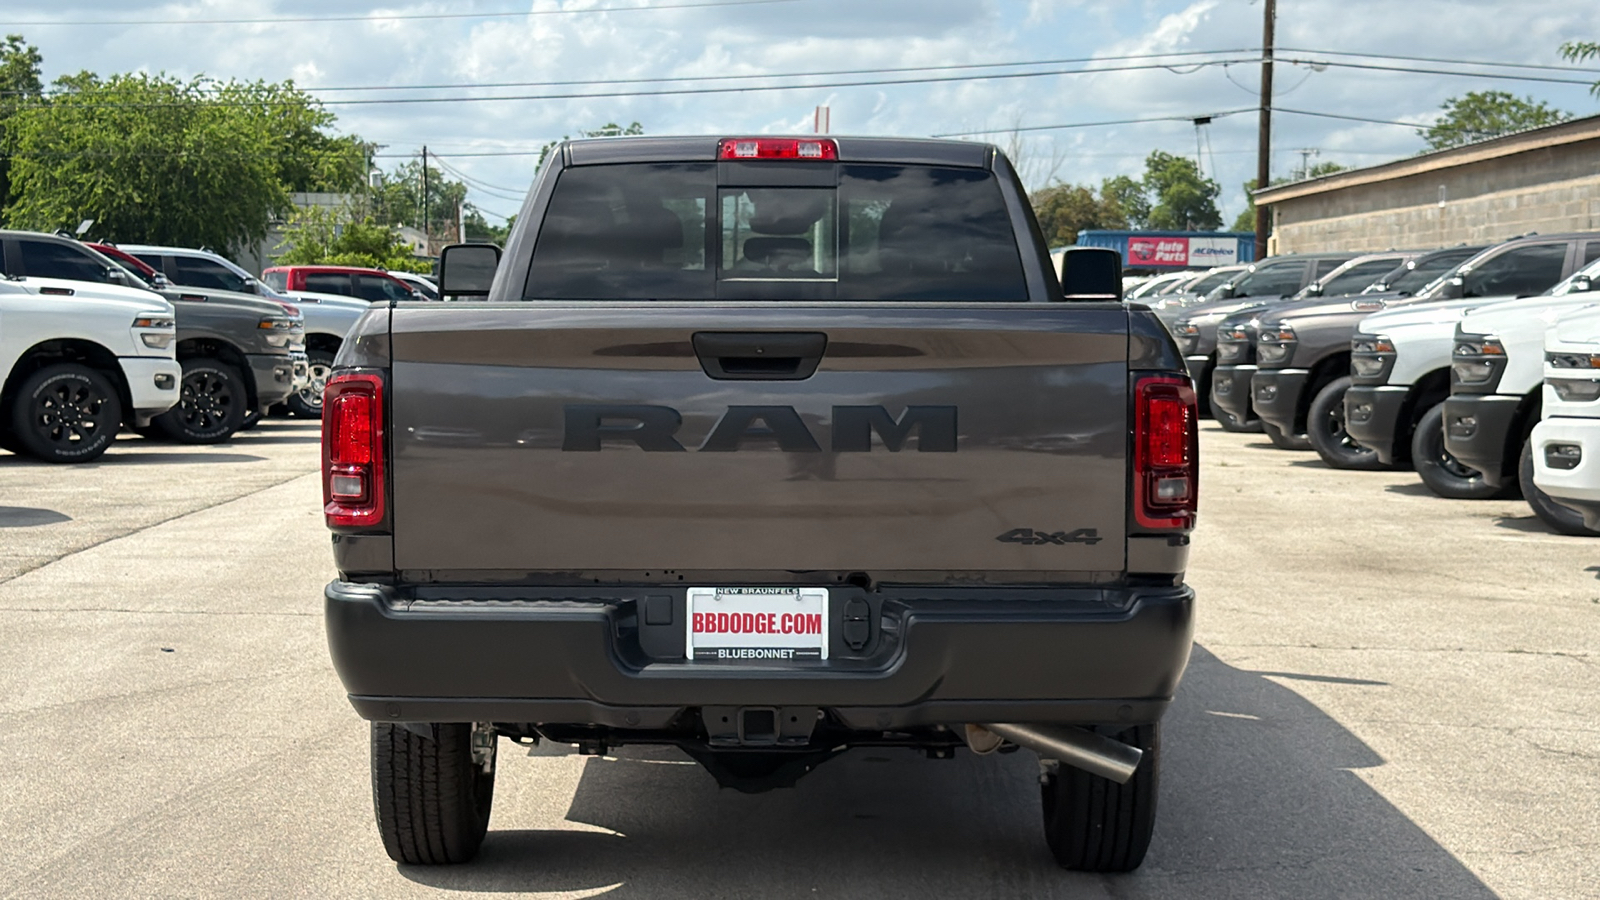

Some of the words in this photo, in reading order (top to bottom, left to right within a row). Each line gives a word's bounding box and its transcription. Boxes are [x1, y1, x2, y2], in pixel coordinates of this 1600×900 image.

[1156, 241, 1184, 252] Auto
[1155, 252, 1185, 261] Parts
[562, 405, 958, 452] RAM
[995, 528, 1103, 545] 4x4
[692, 612, 822, 635] BBDODGE.COM
[718, 649, 795, 659] BLUEBONNET
